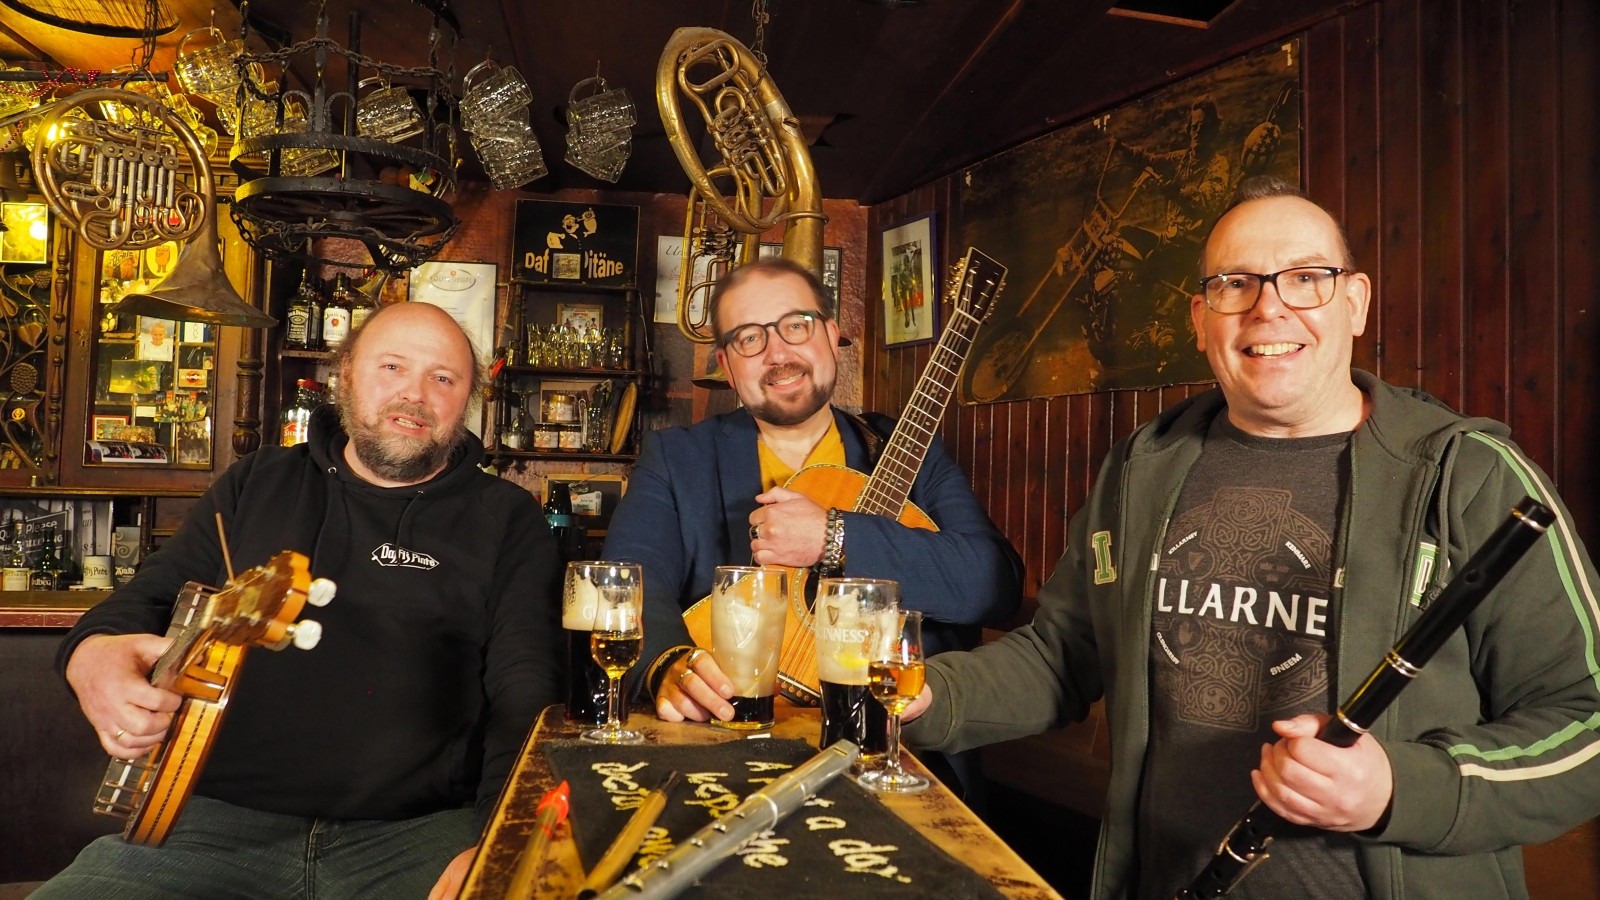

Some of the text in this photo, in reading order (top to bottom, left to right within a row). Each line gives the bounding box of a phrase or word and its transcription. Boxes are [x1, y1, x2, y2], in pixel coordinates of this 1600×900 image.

[1285, 540, 1312, 570] KENMARE
[1158, 577, 1329, 637] LLARNE
[1269, 652, 1303, 676] SNEEM
